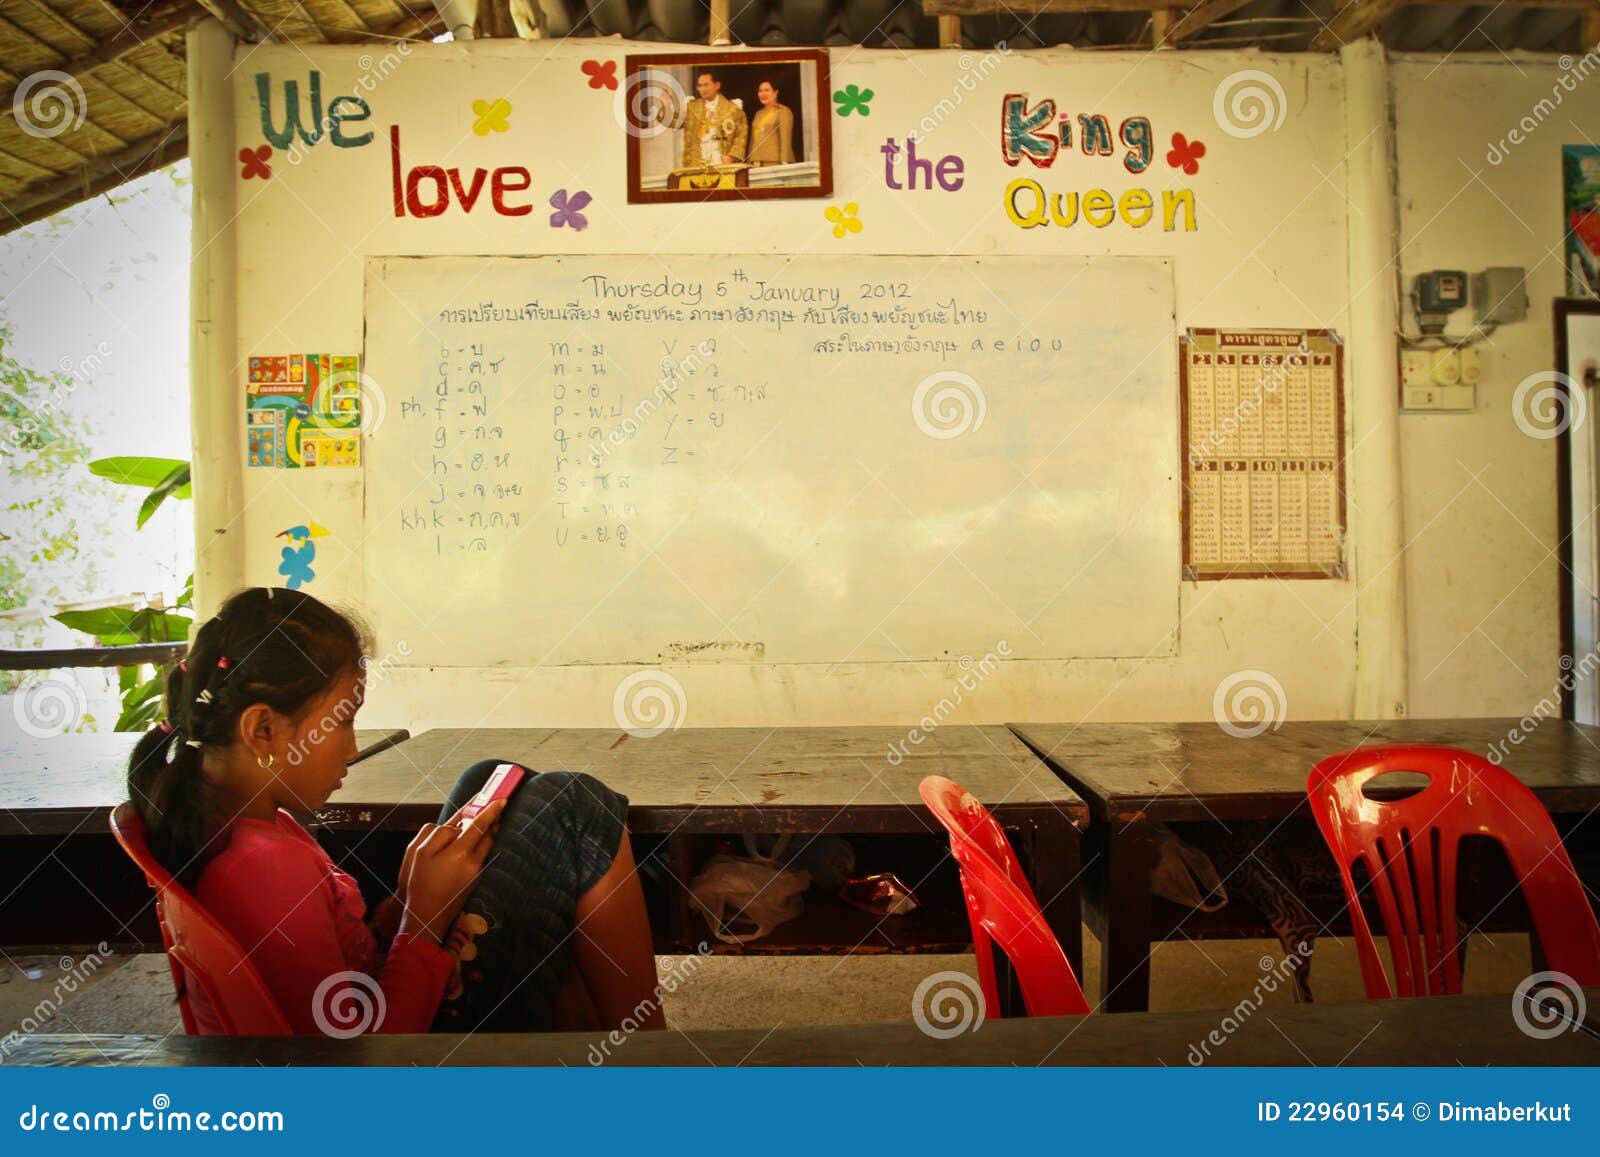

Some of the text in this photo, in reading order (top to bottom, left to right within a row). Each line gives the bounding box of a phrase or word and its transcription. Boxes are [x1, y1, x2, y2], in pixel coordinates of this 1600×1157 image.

[255, 70, 374, 150] We
[1001, 93, 1154, 174] King
[390, 124, 533, 219] love
[880, 137, 965, 192] the
[1003, 177, 1197, 232] Queen
[582, 275, 702, 306] Thursday
[750, 281, 840, 311] January
[860, 283, 912, 299] 2012
[1257, 461, 1274, 472] 10
